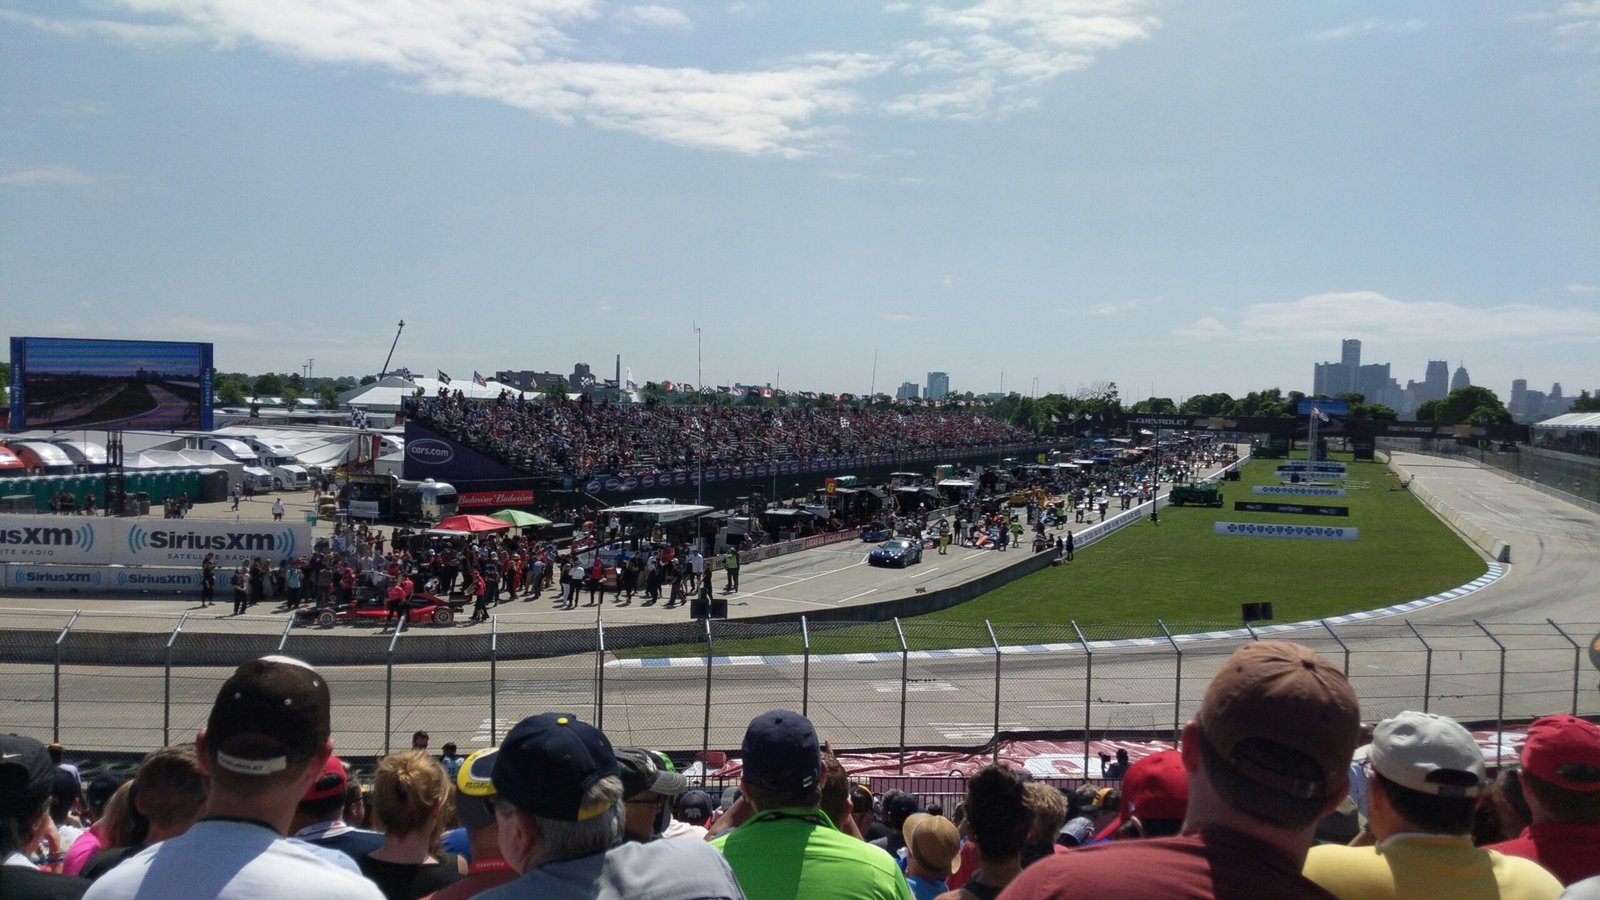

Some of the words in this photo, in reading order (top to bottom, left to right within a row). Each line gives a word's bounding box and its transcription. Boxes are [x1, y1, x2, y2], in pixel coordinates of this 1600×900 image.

[1135, 417, 1188, 426] CHEVROLET
[411, 445, 449, 456] cars.com
[827, 482, 835, 493] 6
[458, 495, 493, 505] Budweiser
[494, 493, 533, 503] Budweiser
[167, 553, 221, 561] SATELLE
